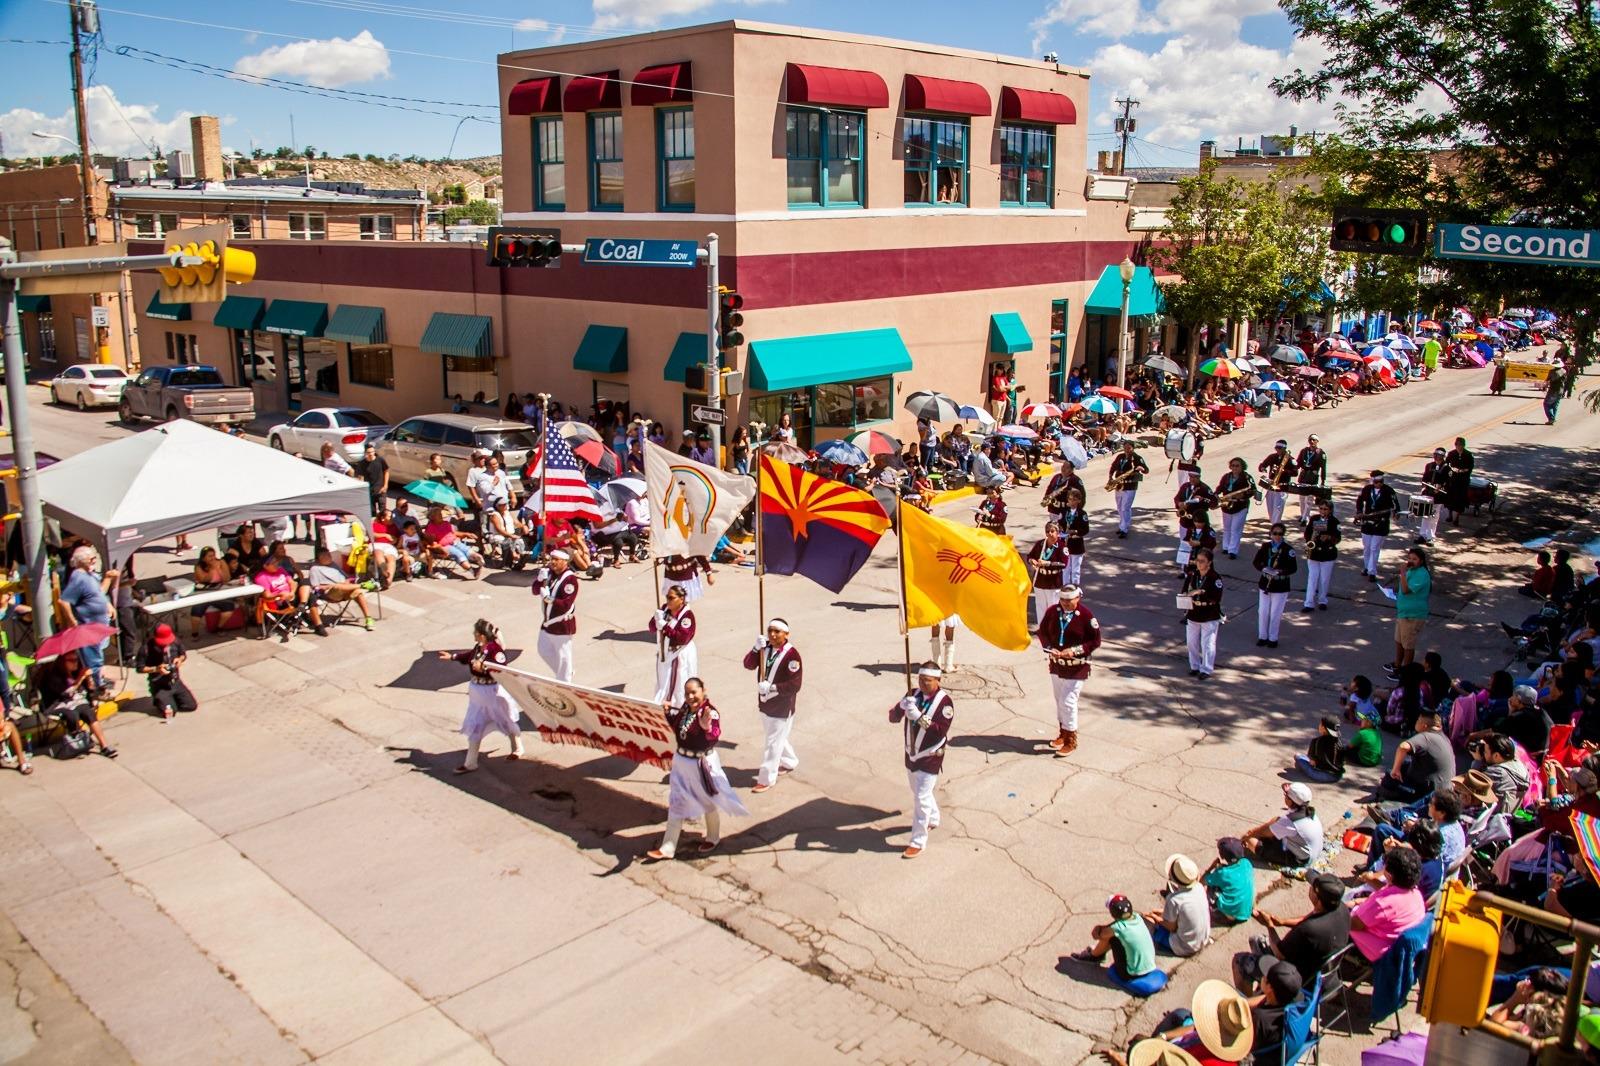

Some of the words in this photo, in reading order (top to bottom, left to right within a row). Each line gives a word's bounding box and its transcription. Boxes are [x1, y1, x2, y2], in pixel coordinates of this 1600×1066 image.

[1460, 225, 1591, 258] Second
[599, 239, 644, 260] Coal
[669, 252, 688, 260] 200W
[95, 317, 106, 325] 15
